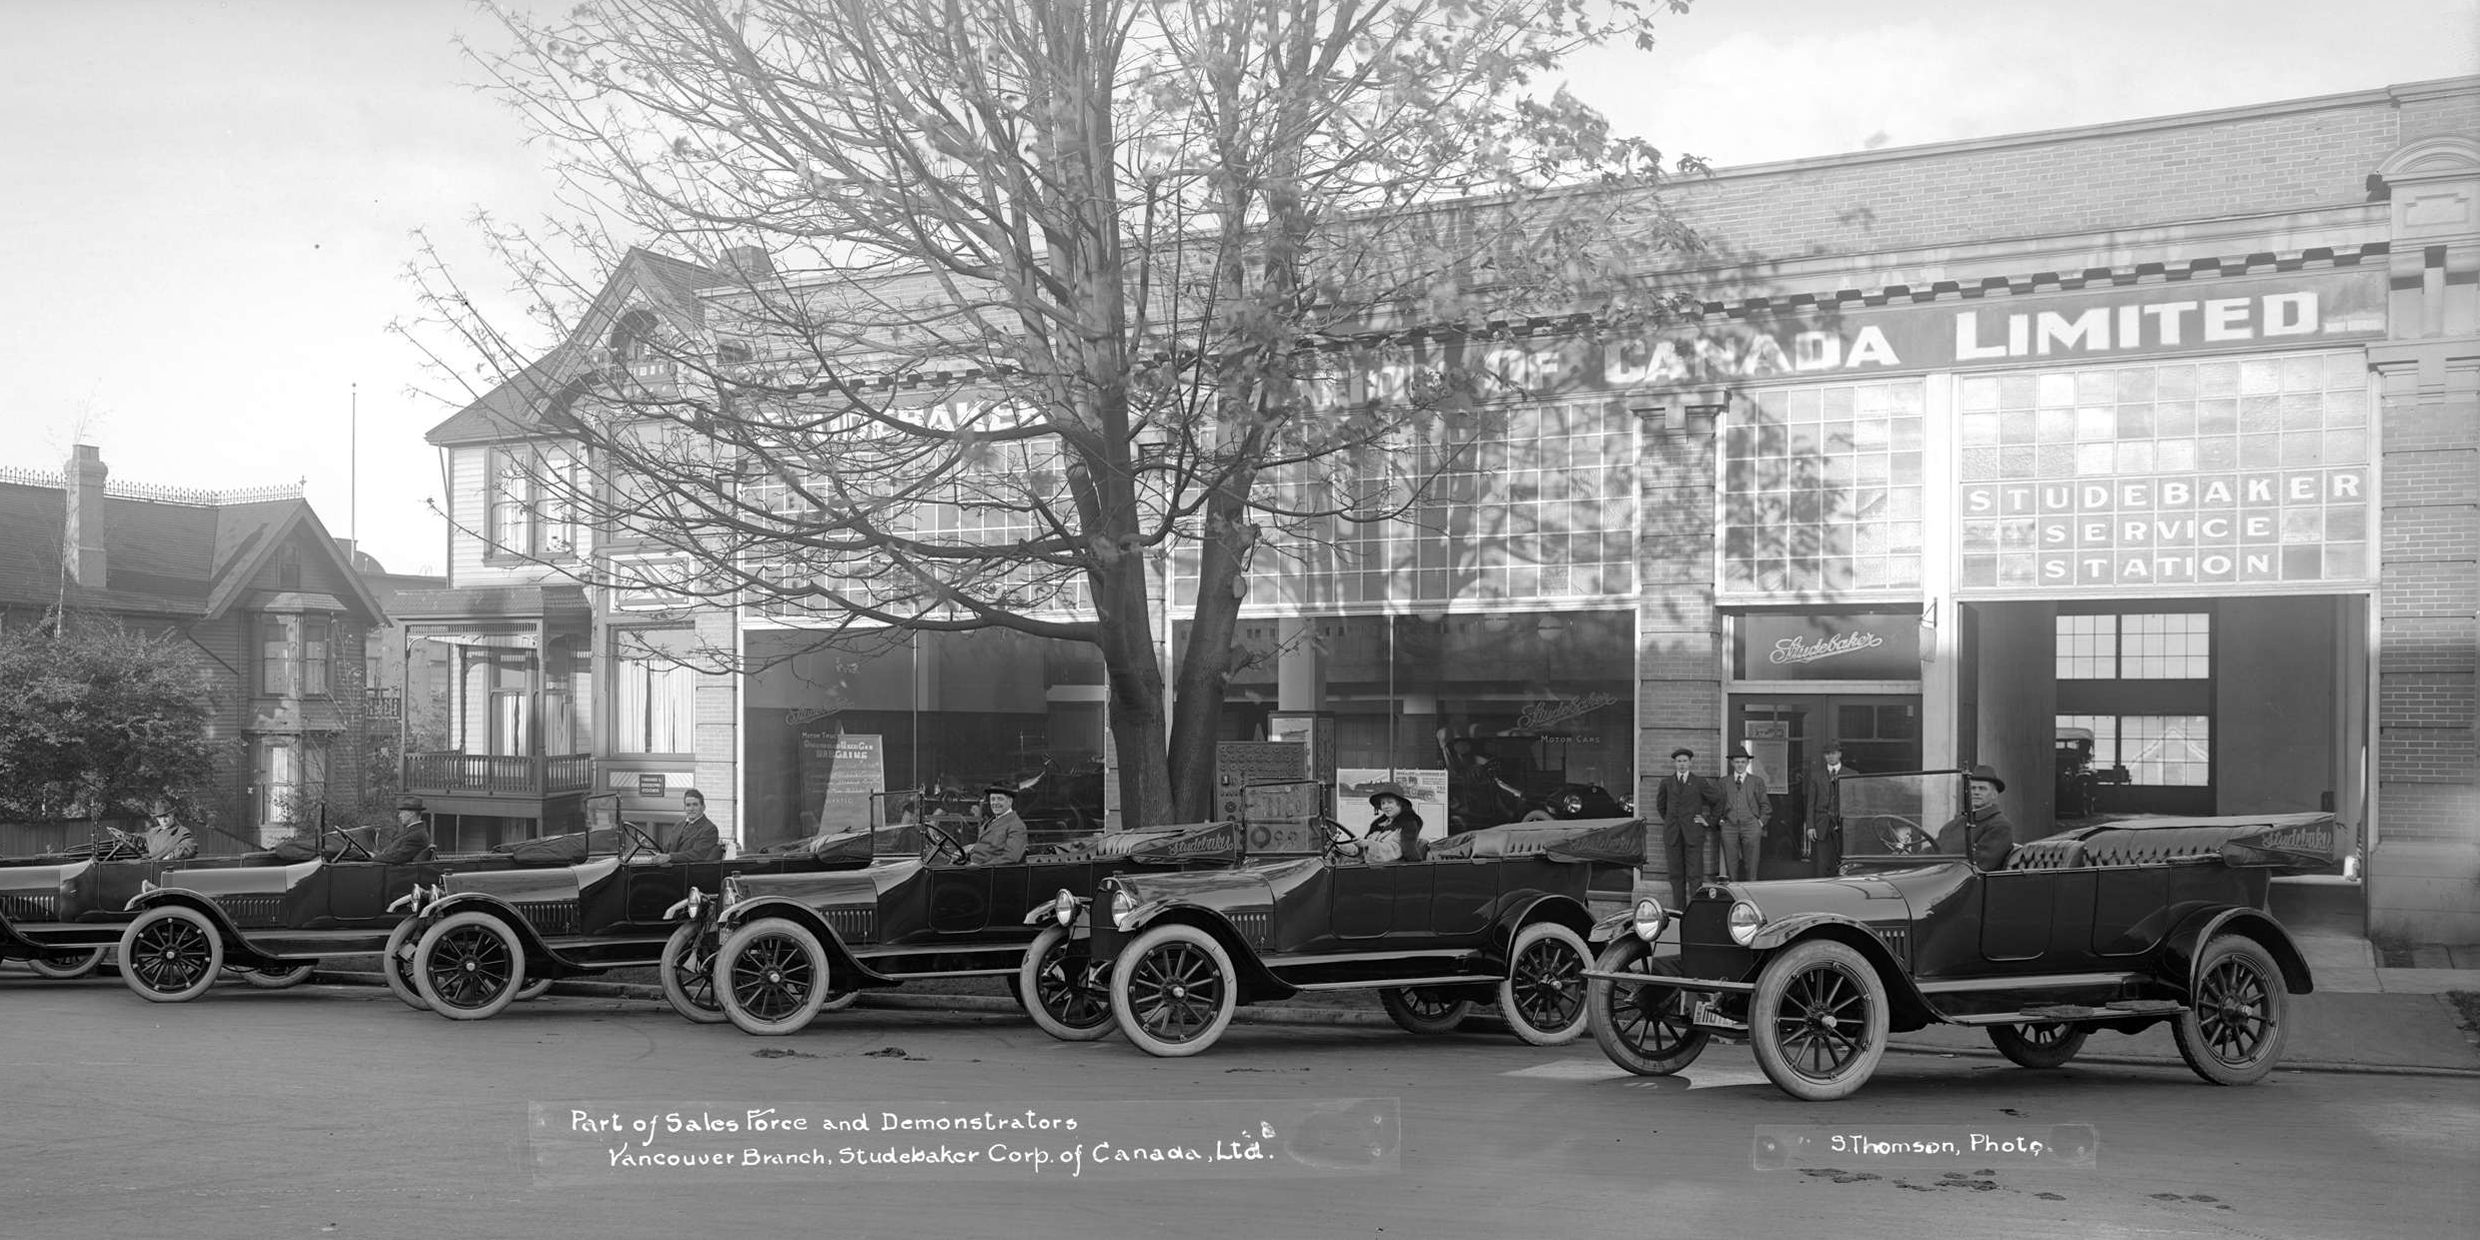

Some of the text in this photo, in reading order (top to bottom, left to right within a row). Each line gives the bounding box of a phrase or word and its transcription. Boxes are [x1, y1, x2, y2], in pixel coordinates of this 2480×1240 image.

[1604, 324, 1900, 383] CANADA
[1956, 291, 2320, 360] LIMITED
[1969, 474, 2361, 512] STUDEBAKER
[2045, 516, 2271, 543] SERVICE
[2045, 553, 2271, 578] STATION
[1769, 631, 1883, 664] Studebaker
